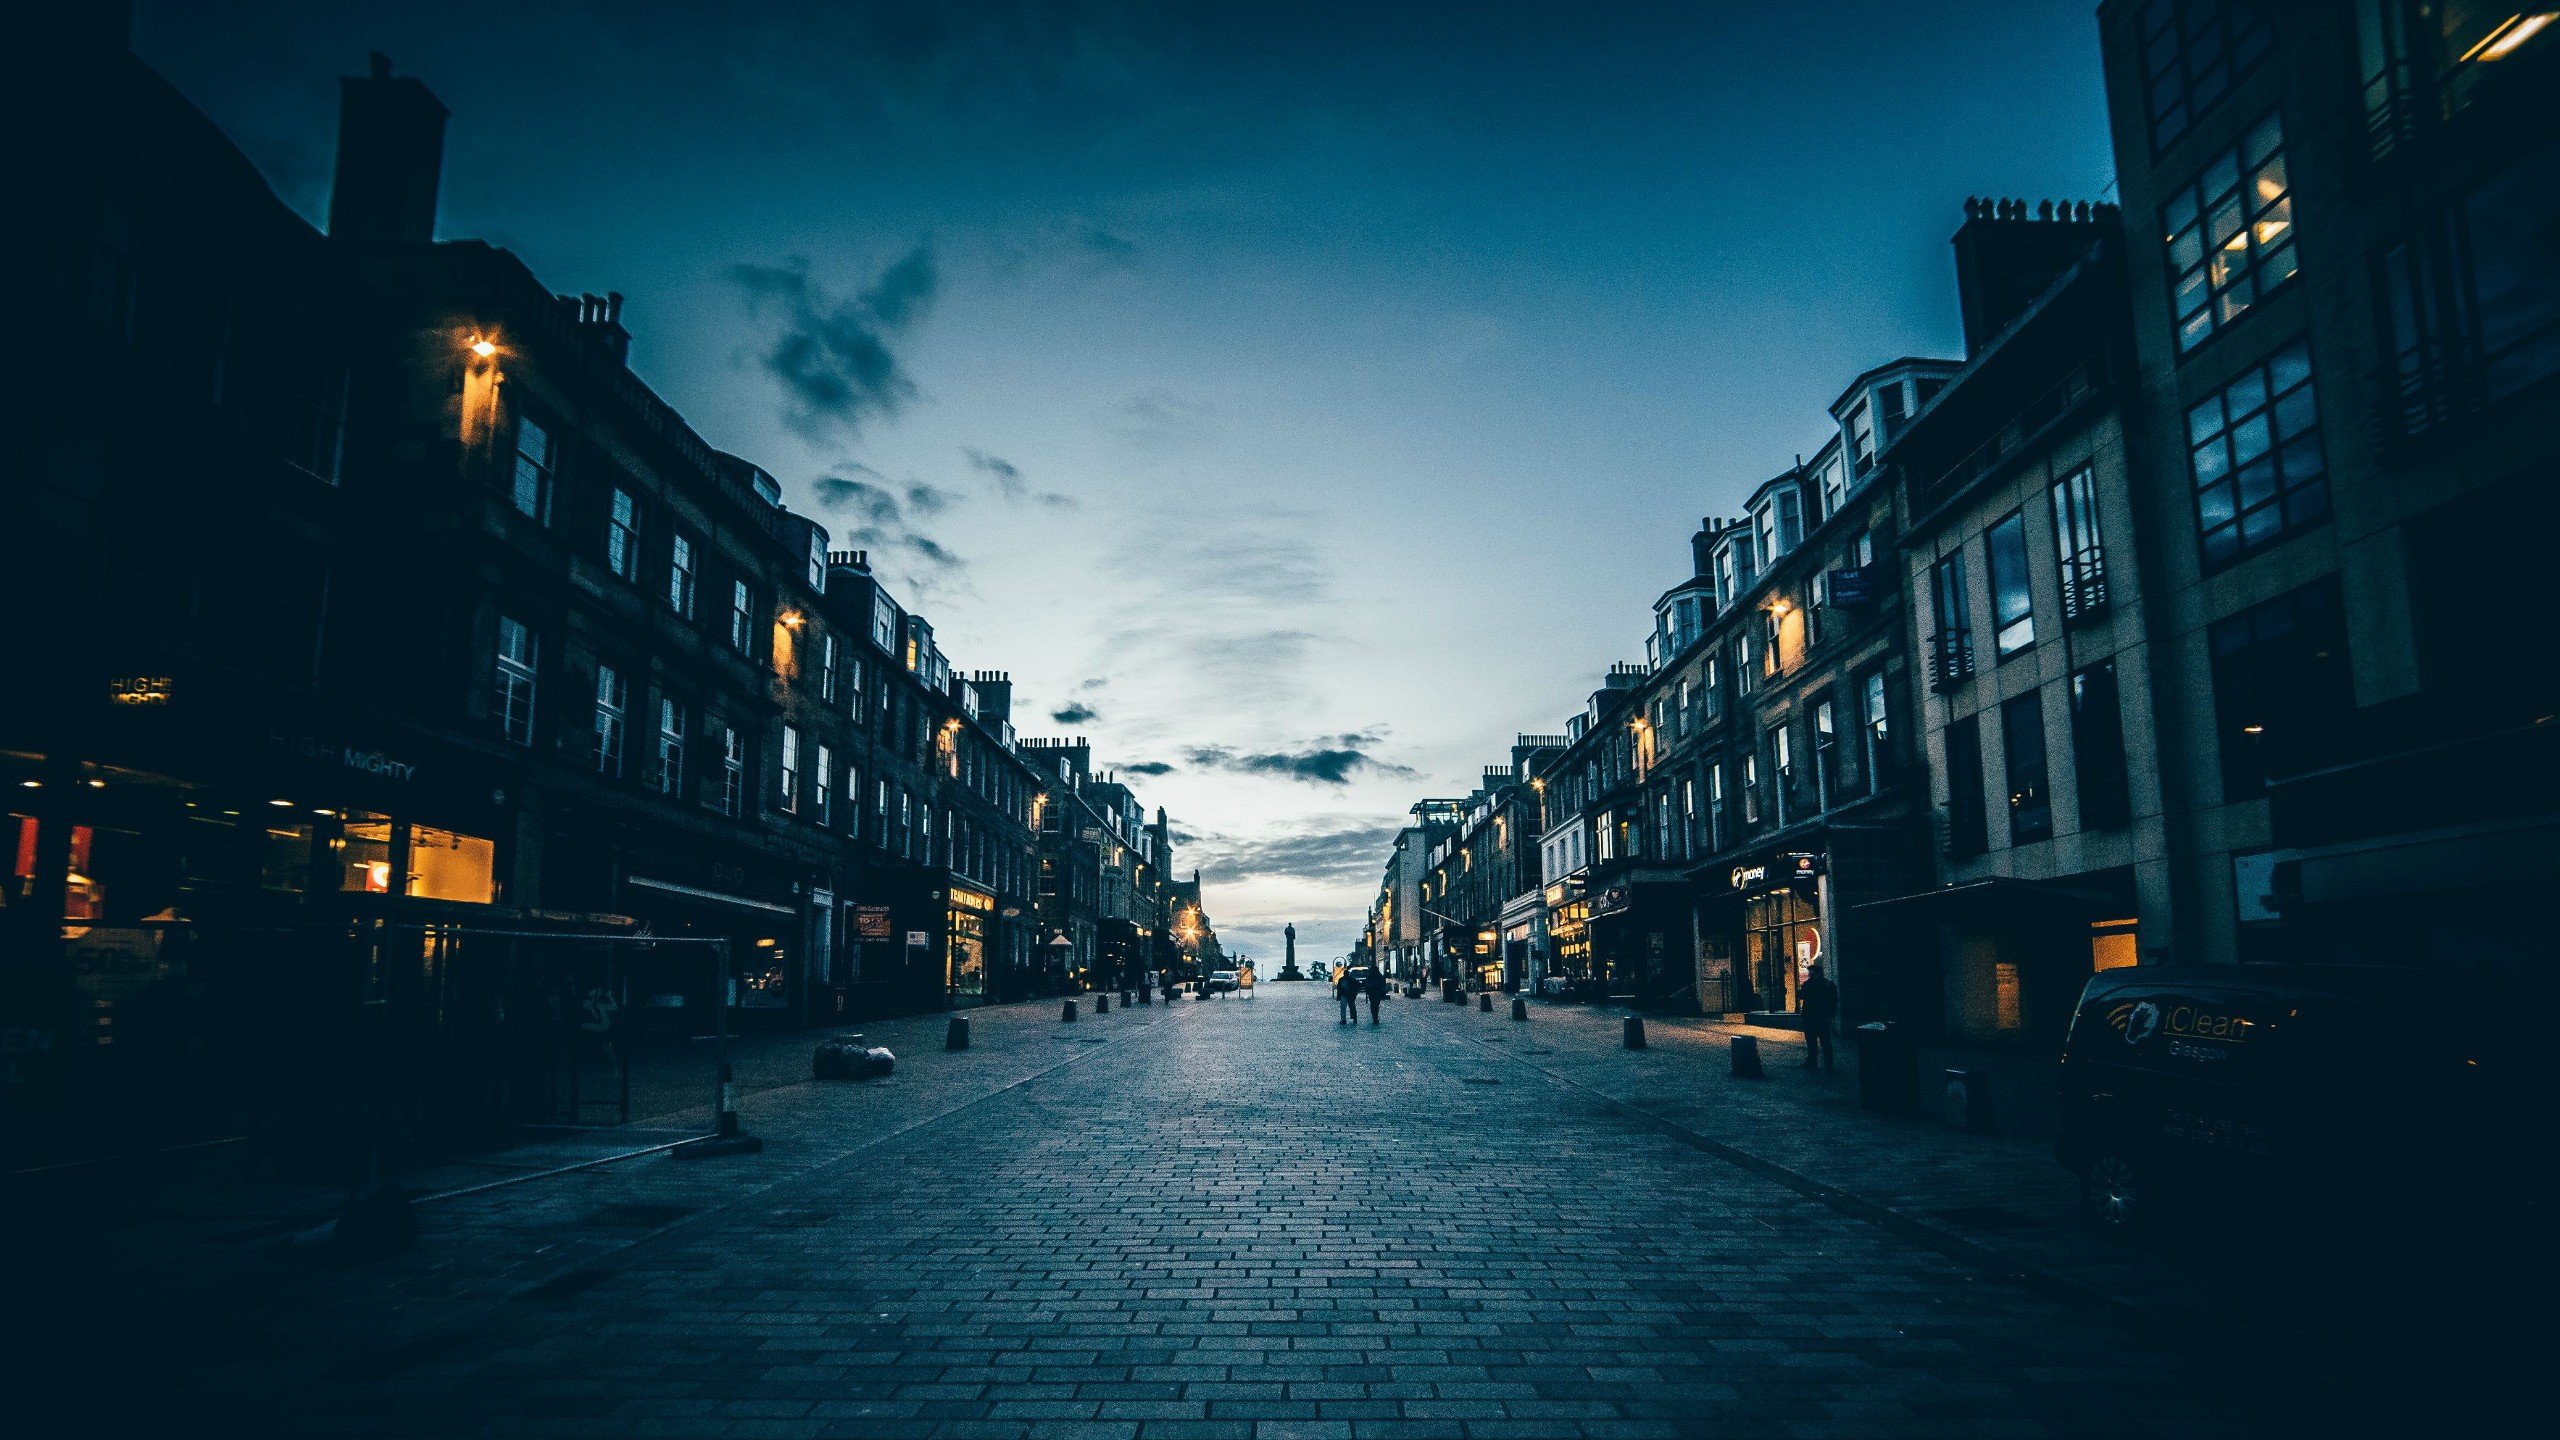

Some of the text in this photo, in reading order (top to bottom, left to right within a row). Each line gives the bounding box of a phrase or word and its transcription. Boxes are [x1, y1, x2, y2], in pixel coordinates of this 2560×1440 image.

[344, 745, 417, 783] MIGHTY
[1743, 865, 1765, 880] money
[2165, 1005, 2246, 1038] iClean
[2168, 1040, 2229, 1063] Glasgow
